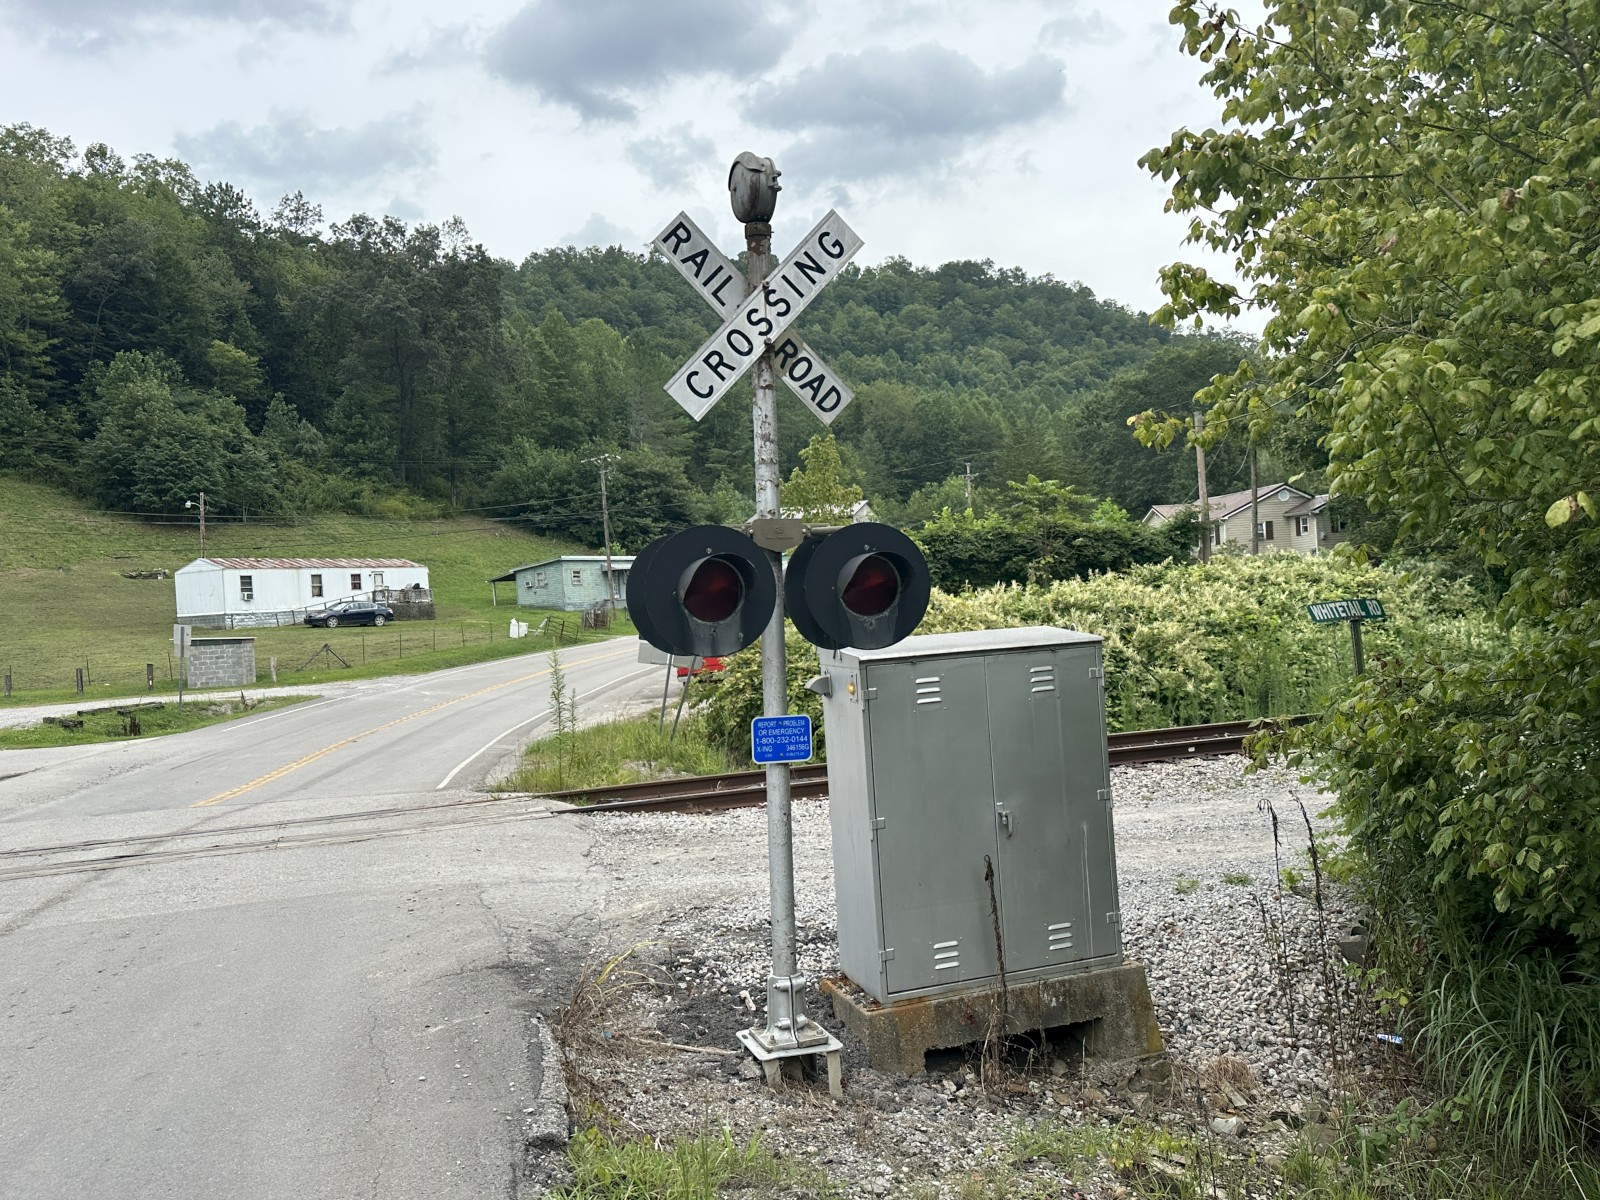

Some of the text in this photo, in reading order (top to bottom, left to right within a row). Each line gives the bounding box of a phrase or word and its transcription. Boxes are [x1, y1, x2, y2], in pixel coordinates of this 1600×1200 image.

[661, 221, 842, 413] RAIL ROAD
[685, 231, 845, 399] CROSSING
[1309, 600, 1382, 620] WHITETAIL RD
[756, 735, 808, 744] 1-800-232-0144
